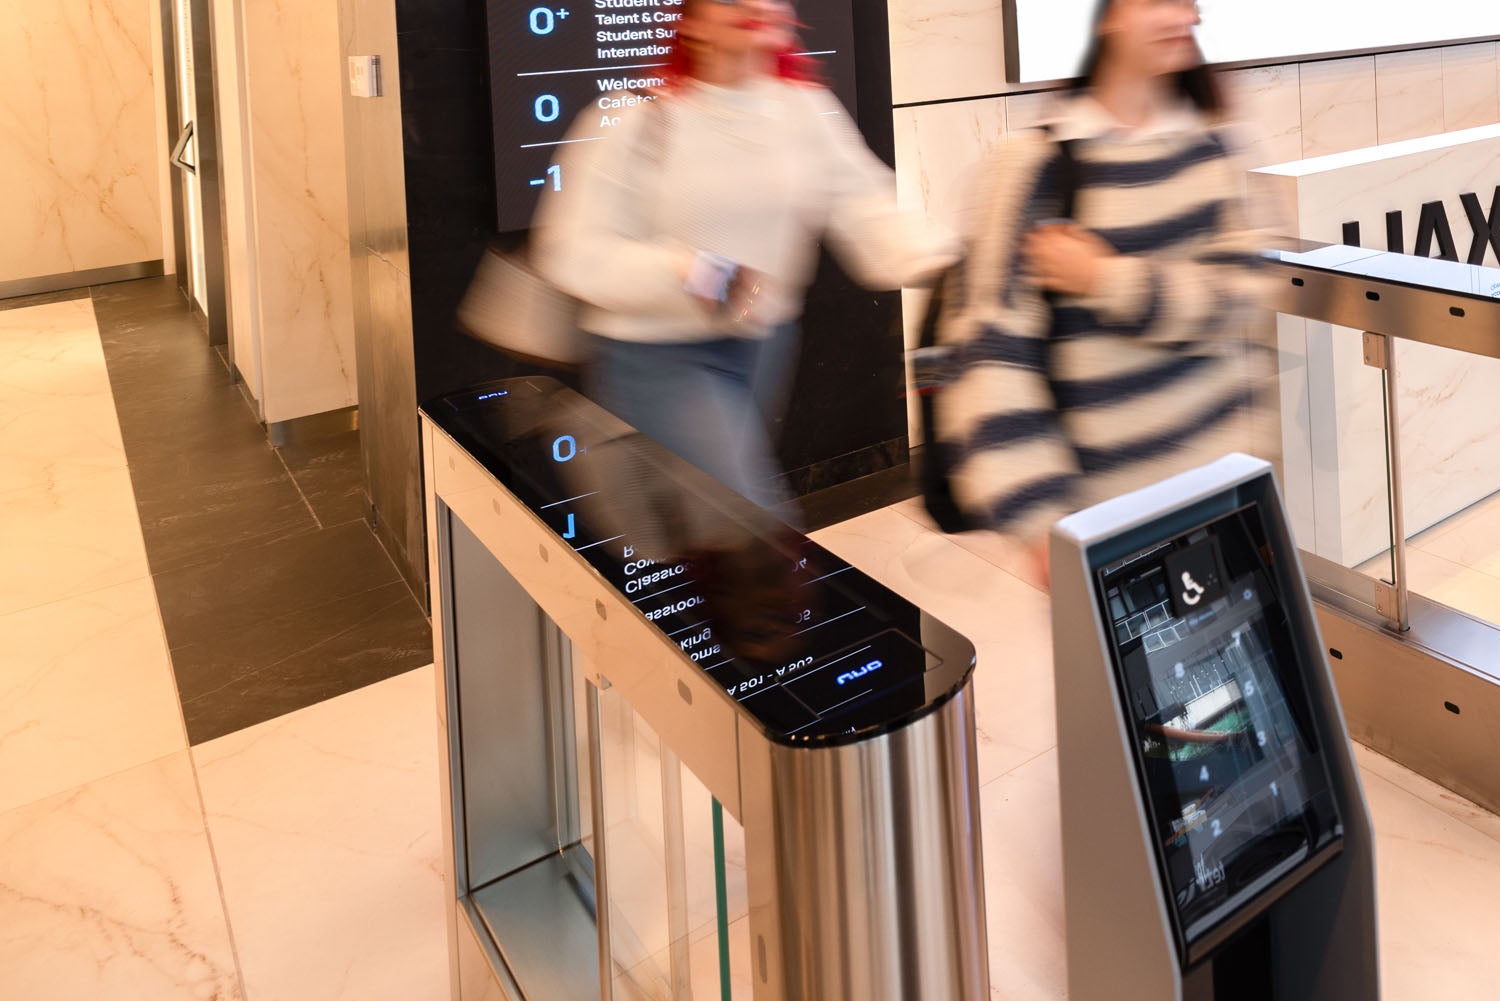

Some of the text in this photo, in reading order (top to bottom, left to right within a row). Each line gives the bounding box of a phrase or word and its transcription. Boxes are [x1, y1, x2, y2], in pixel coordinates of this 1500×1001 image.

[595, 13, 639, 25] Talent
[596, 29, 653, 42] Student
[534, 94, 560, 123] 0
[529, 164, 562, 192] -1
